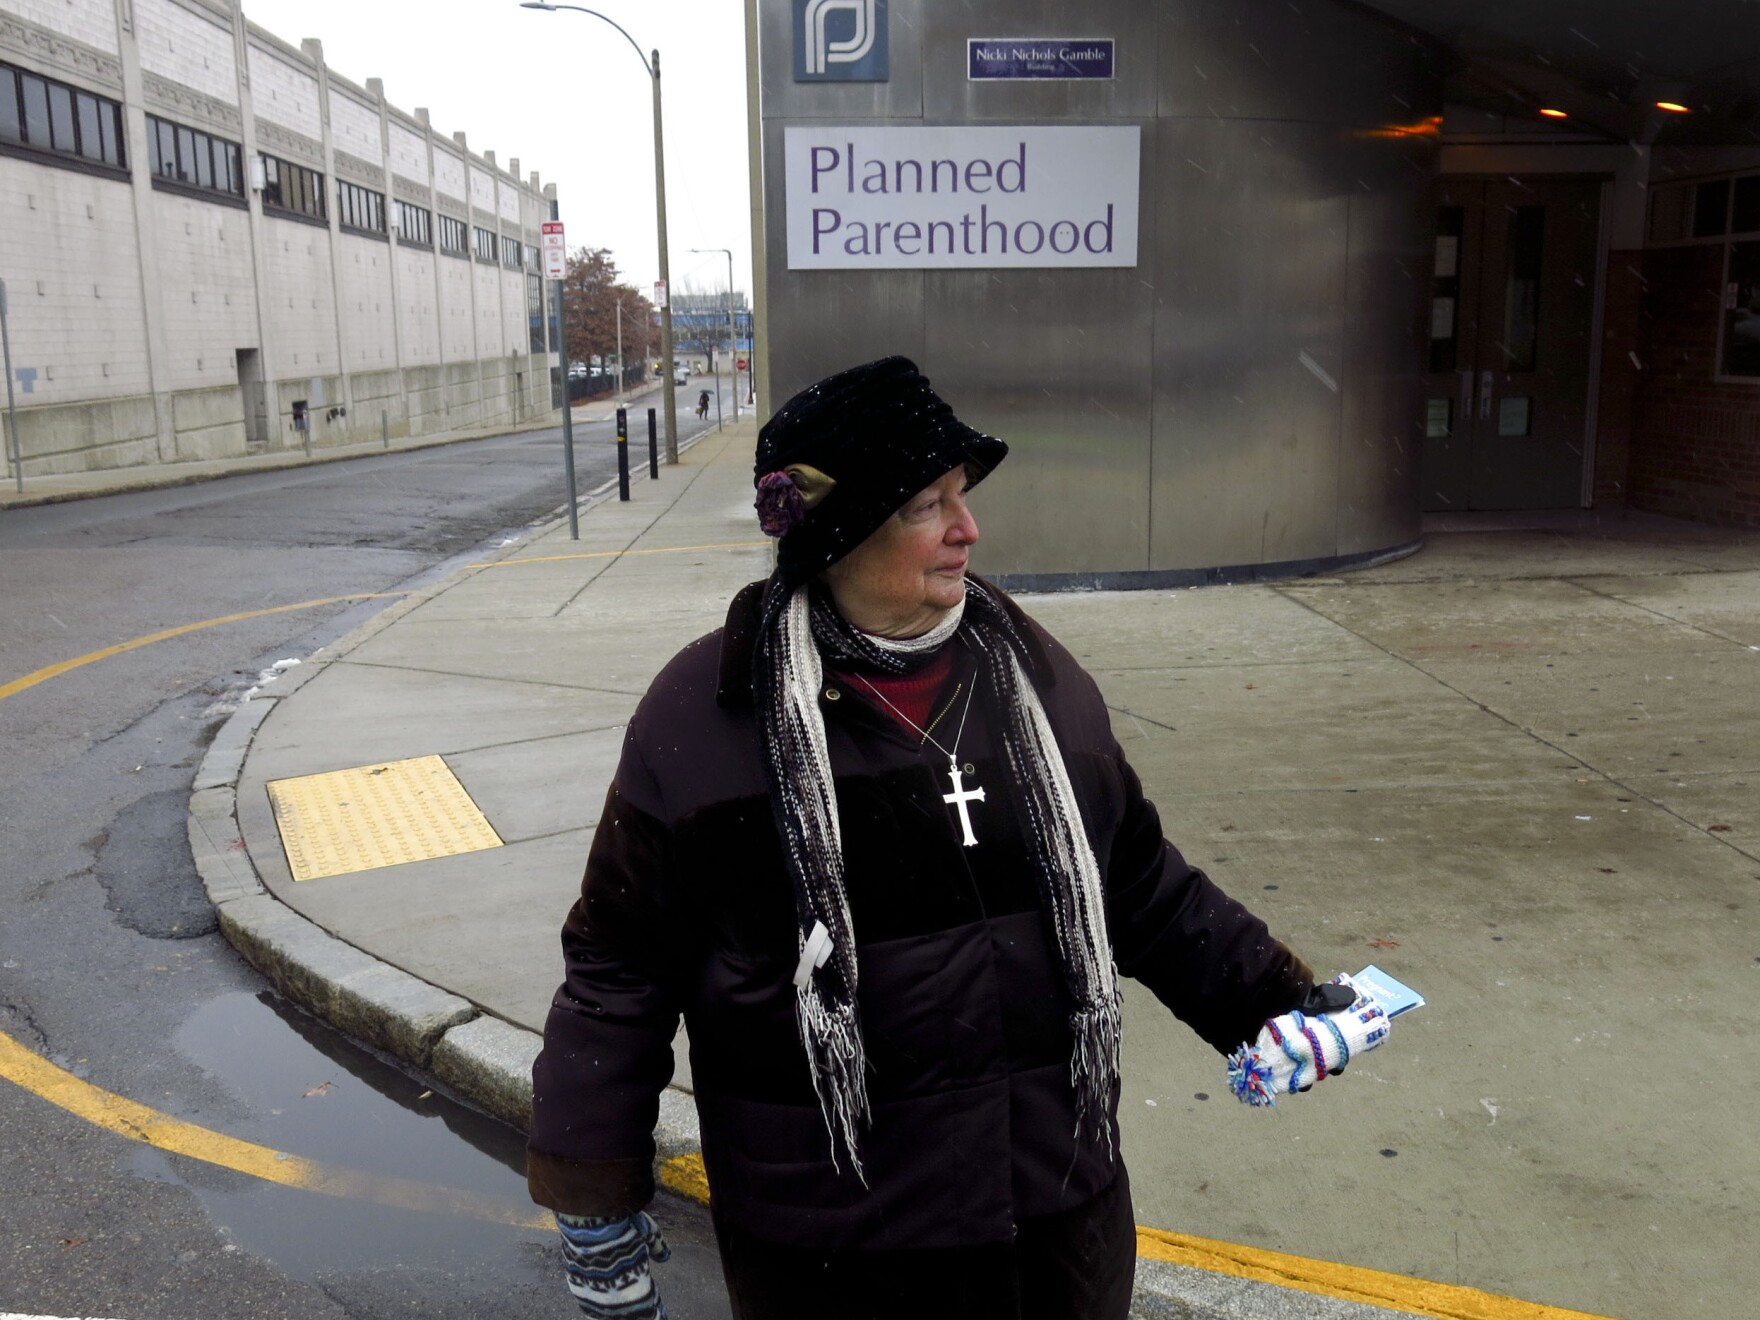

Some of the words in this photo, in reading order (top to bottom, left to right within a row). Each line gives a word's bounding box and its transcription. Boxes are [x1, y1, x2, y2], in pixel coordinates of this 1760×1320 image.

[976, 48, 1007, 61] Nicki
[1012, 48, 1056, 61] Nichols
[1059, 47, 1106, 61] Gamble
[1027, 63, 1056, 71] Building
[810, 142, 1027, 194] Planned
[812, 203, 1115, 255] Parenthood
